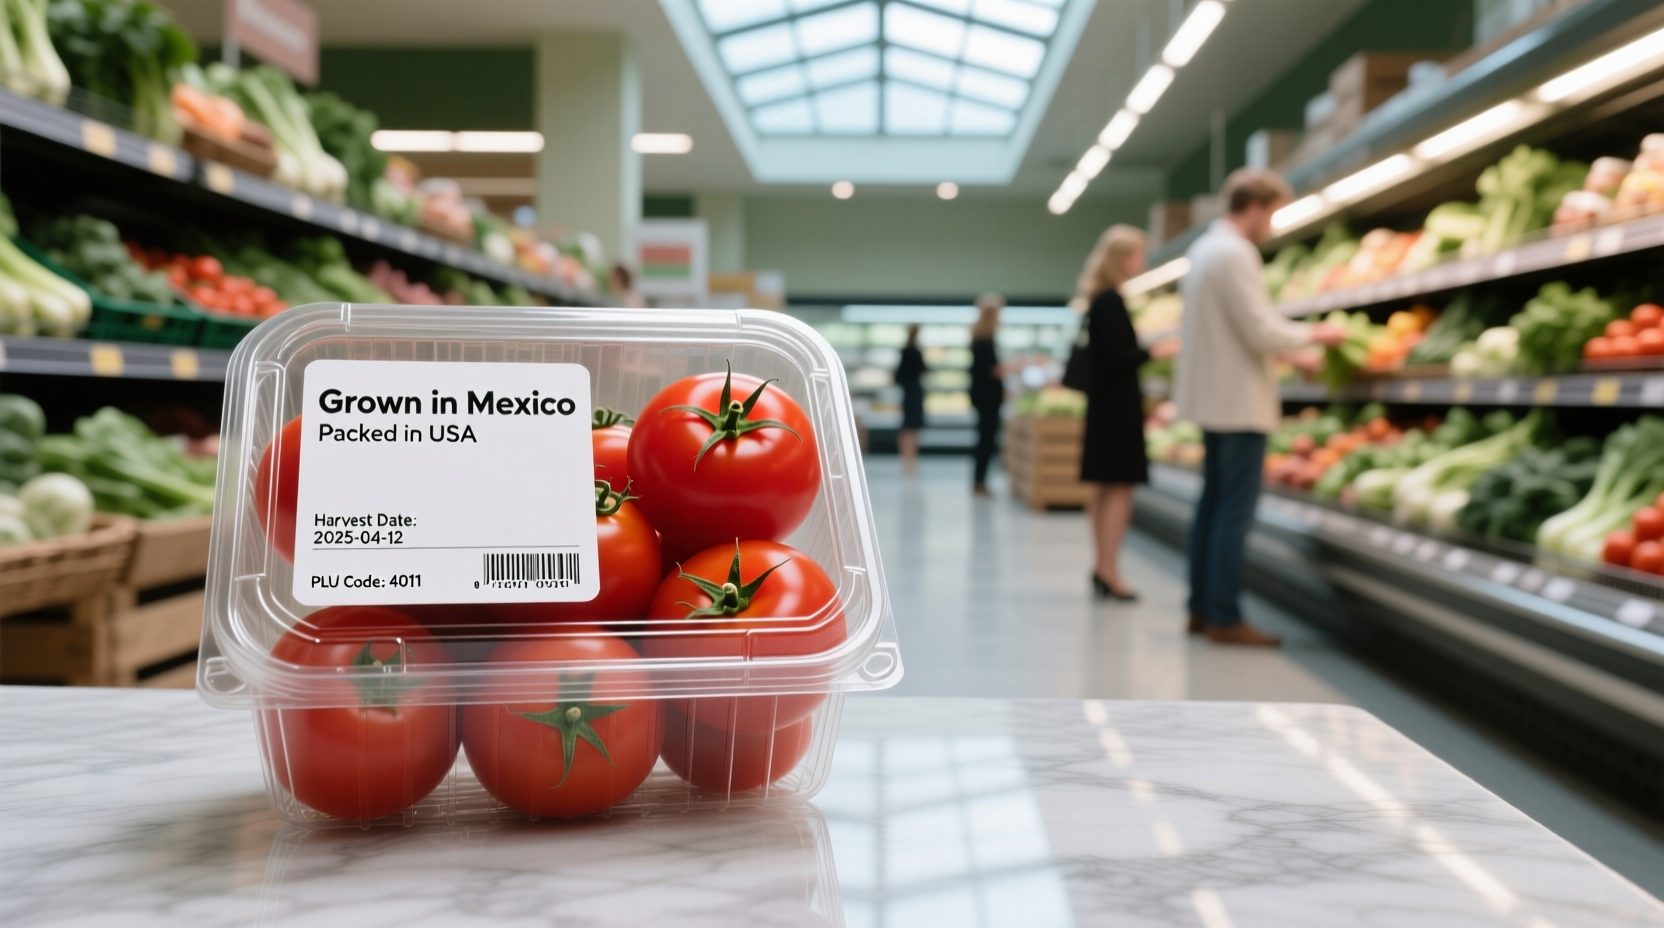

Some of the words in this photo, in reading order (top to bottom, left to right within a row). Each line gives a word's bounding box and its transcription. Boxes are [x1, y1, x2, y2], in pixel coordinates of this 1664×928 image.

[318, 388, 422, 414] Grown
[431, 388, 458, 415] in
[467, 389, 576, 416] Mexico
[318, 423, 397, 443] Packed
[404, 424, 422, 443] in
[429, 424, 477, 443] USA
[314, 513, 373, 528] Harvest
[377, 512, 417, 527] Date:
[313, 530, 404, 545] 2025-04-12
[311, 574, 340, 589] PLU
[343, 574, 386, 589] Code:
[389, 573, 421, 588] 4011
